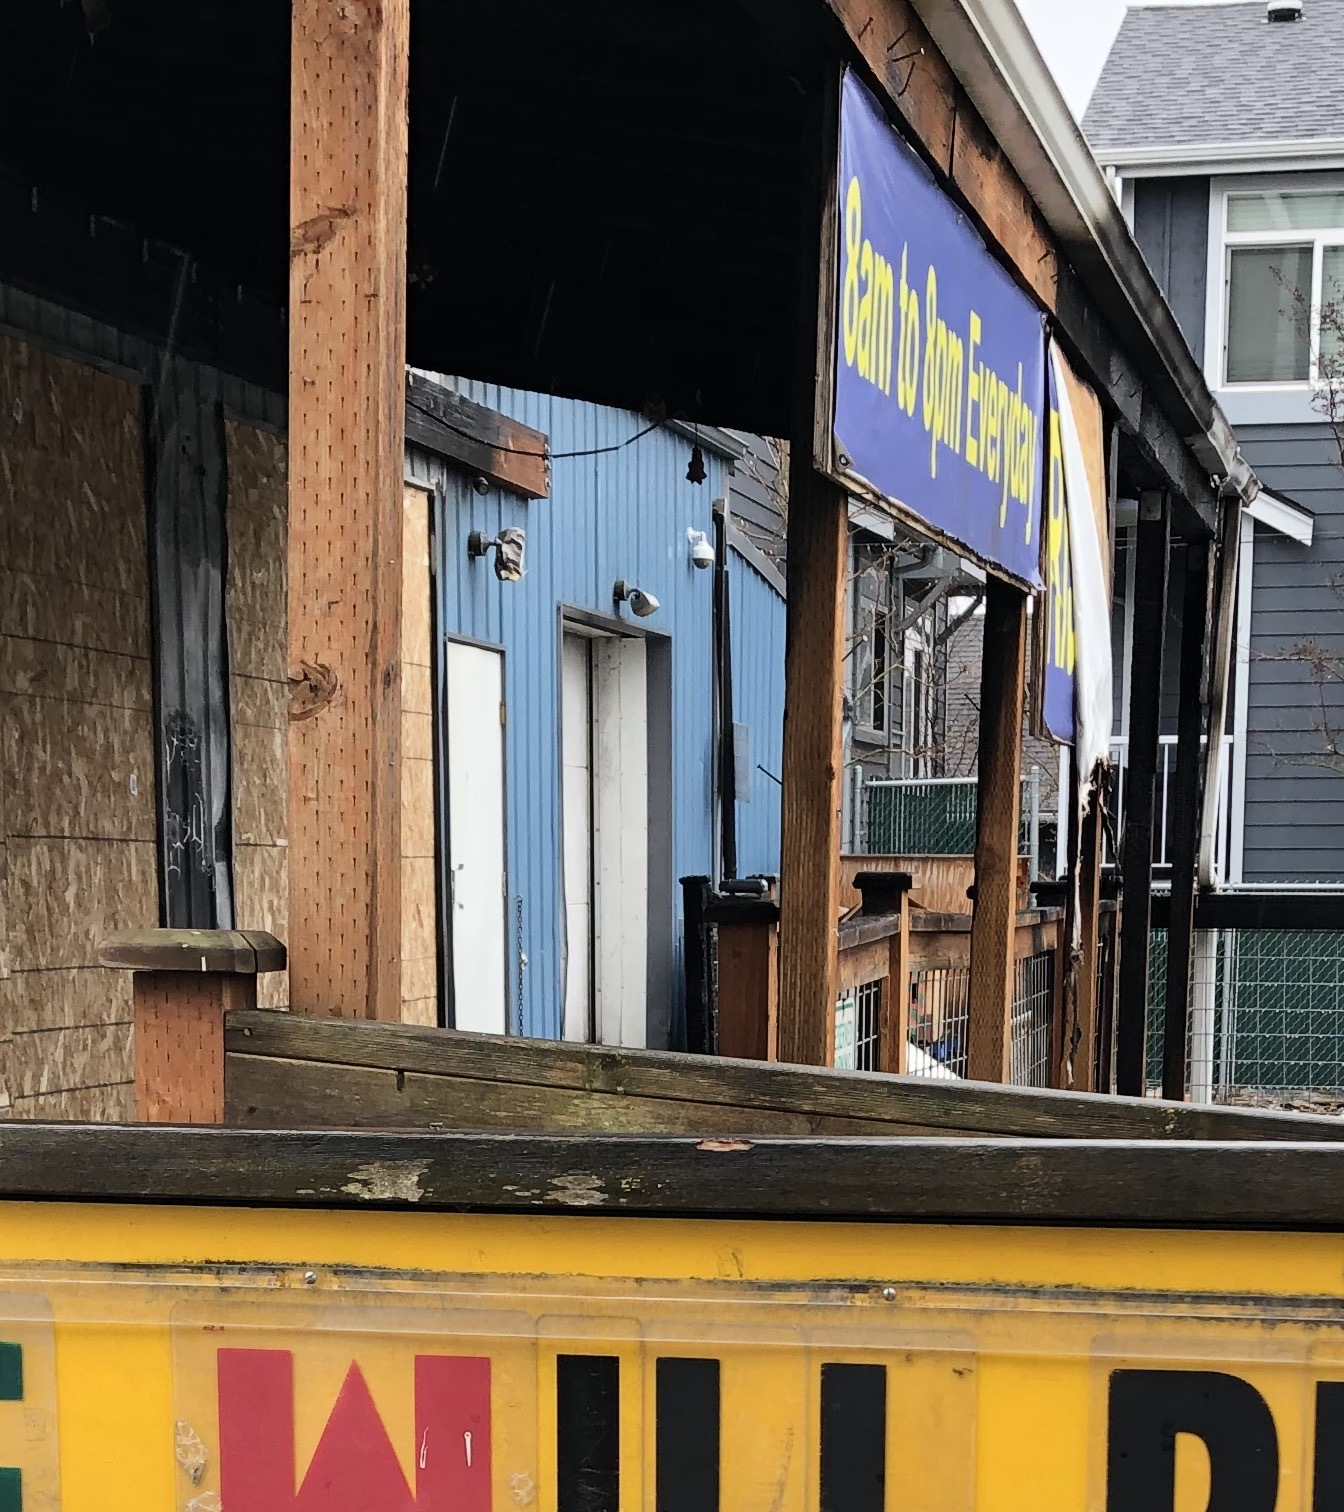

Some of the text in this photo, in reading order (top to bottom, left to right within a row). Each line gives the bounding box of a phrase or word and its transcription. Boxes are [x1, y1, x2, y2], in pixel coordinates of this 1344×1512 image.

[843, 176, 1038, 546] 8am to 8pm Everyday
